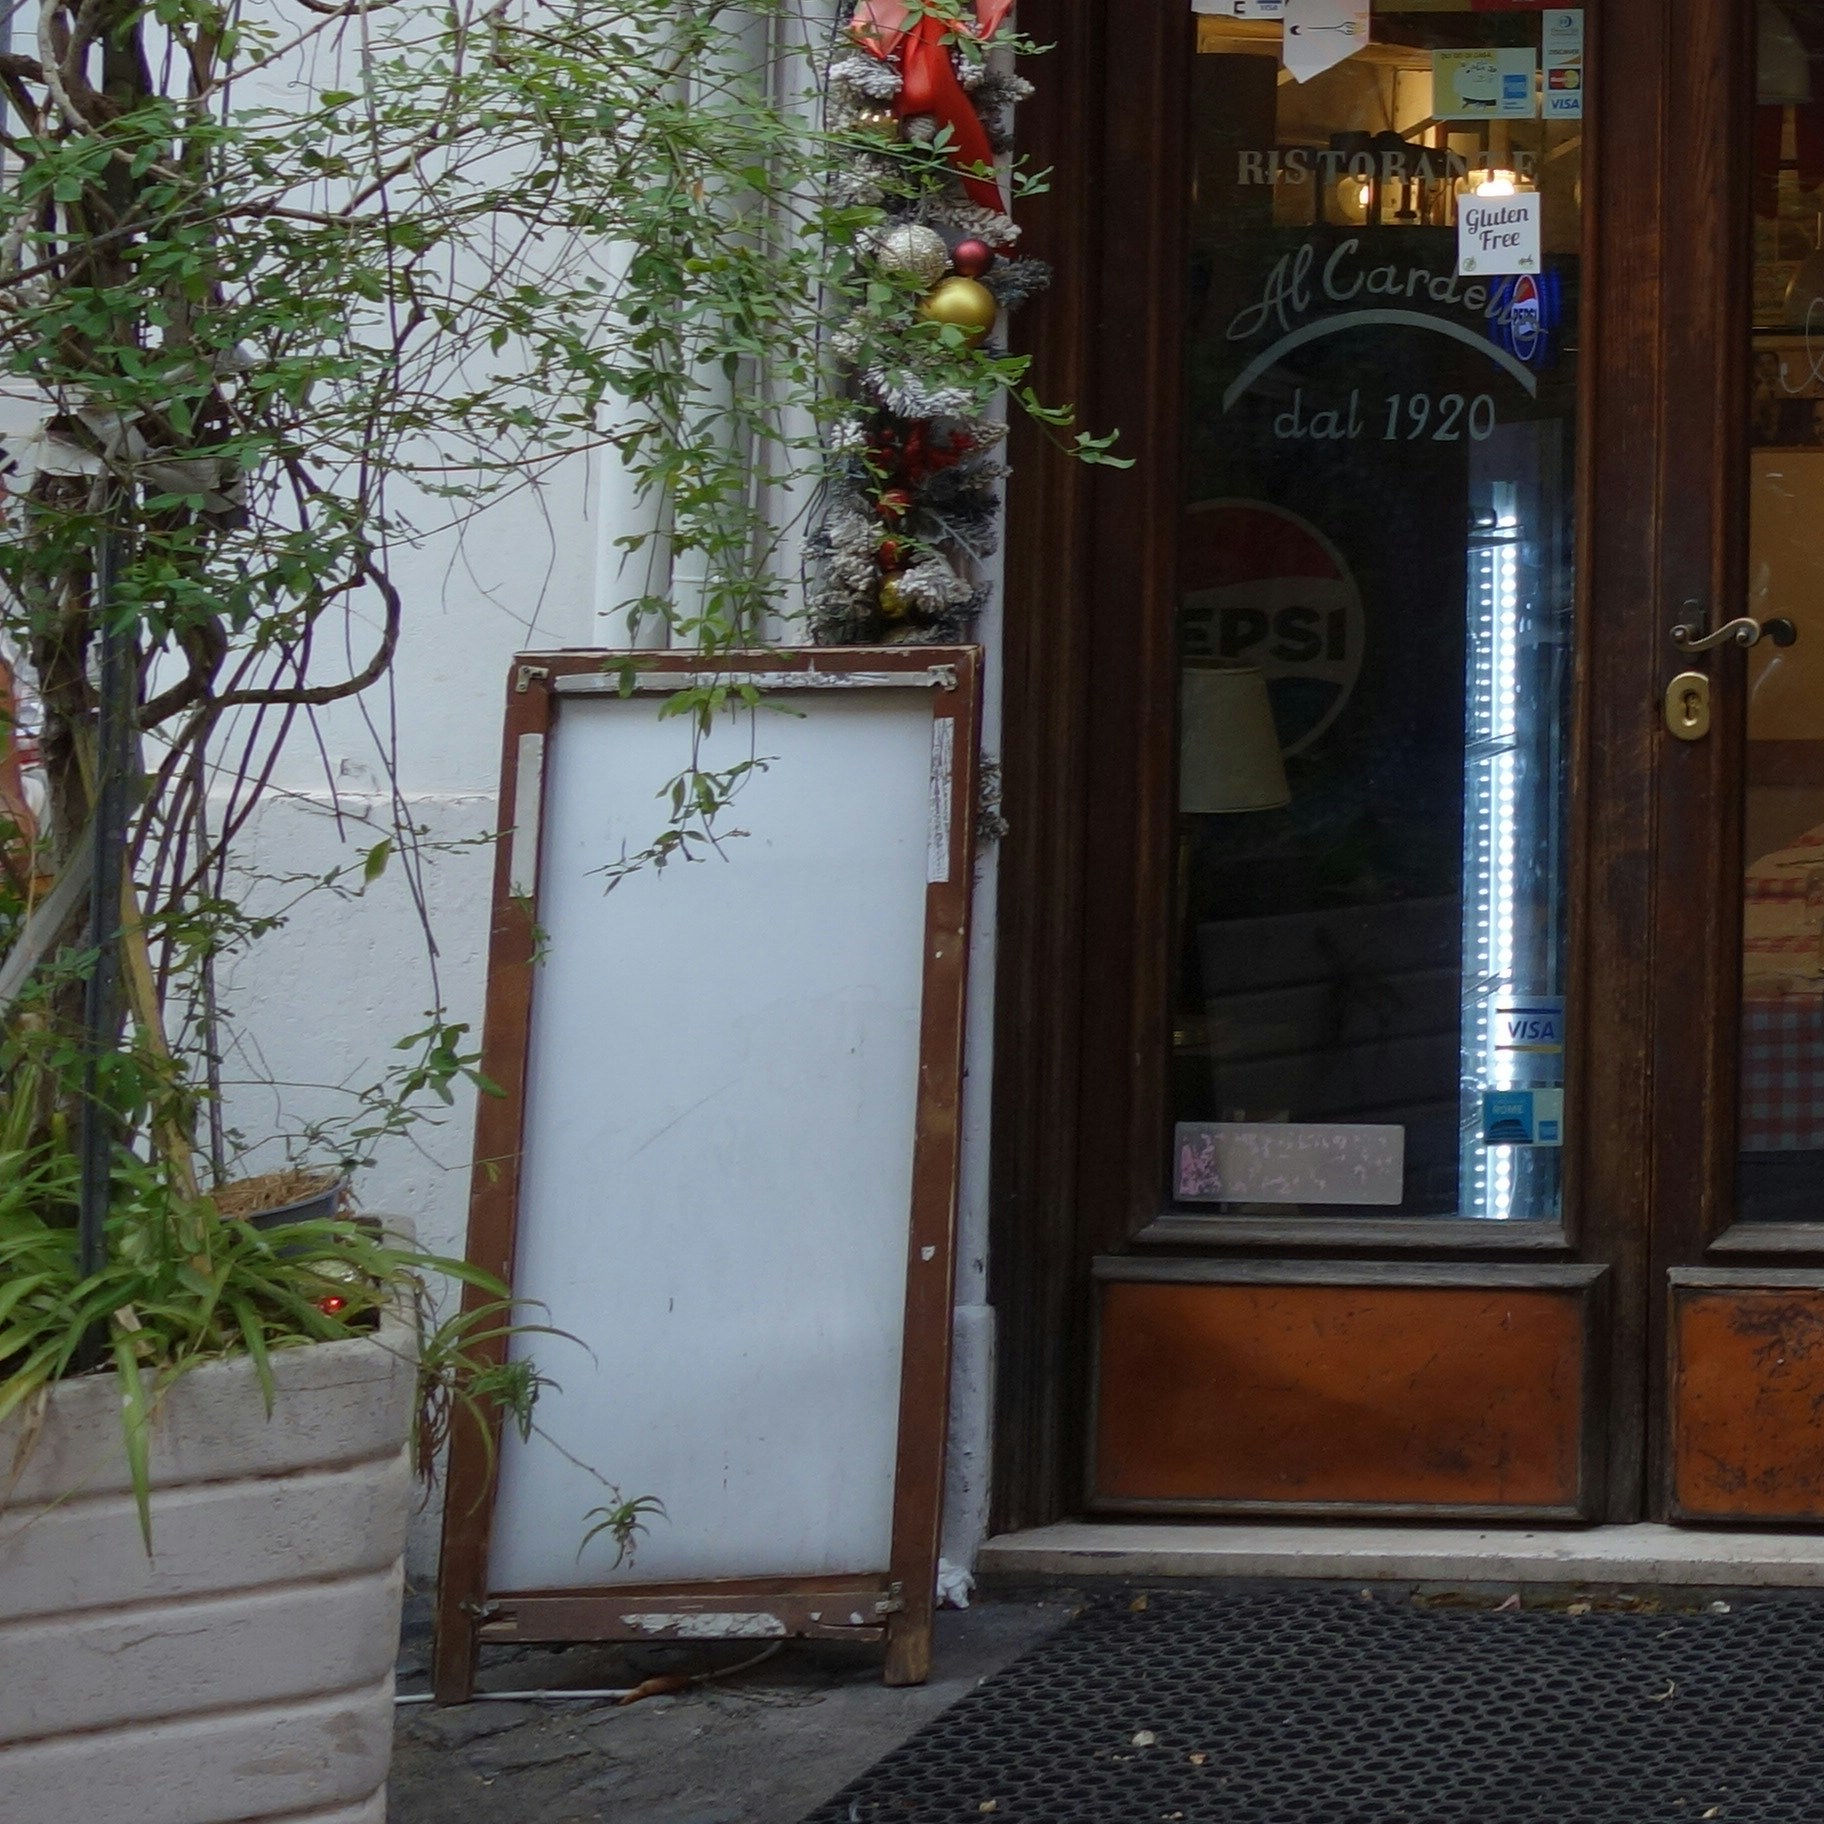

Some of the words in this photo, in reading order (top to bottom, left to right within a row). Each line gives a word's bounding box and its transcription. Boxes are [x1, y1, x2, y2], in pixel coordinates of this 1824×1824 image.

[1551, 98, 1581, 110] VISA
[1237, 149, 1540, 187] RISTORANTE
[1466, 207, 1529, 235] Gluten
[1479, 229, 1520, 251] Free
[1226, 242, 1315, 342] Al
[1274, 387, 1366, 440] dal
[1382, 392, 1497, 442] 1920
[1182, 606, 1347, 662] EPSI
[1508, 1021, 1554, 1039] VISA
